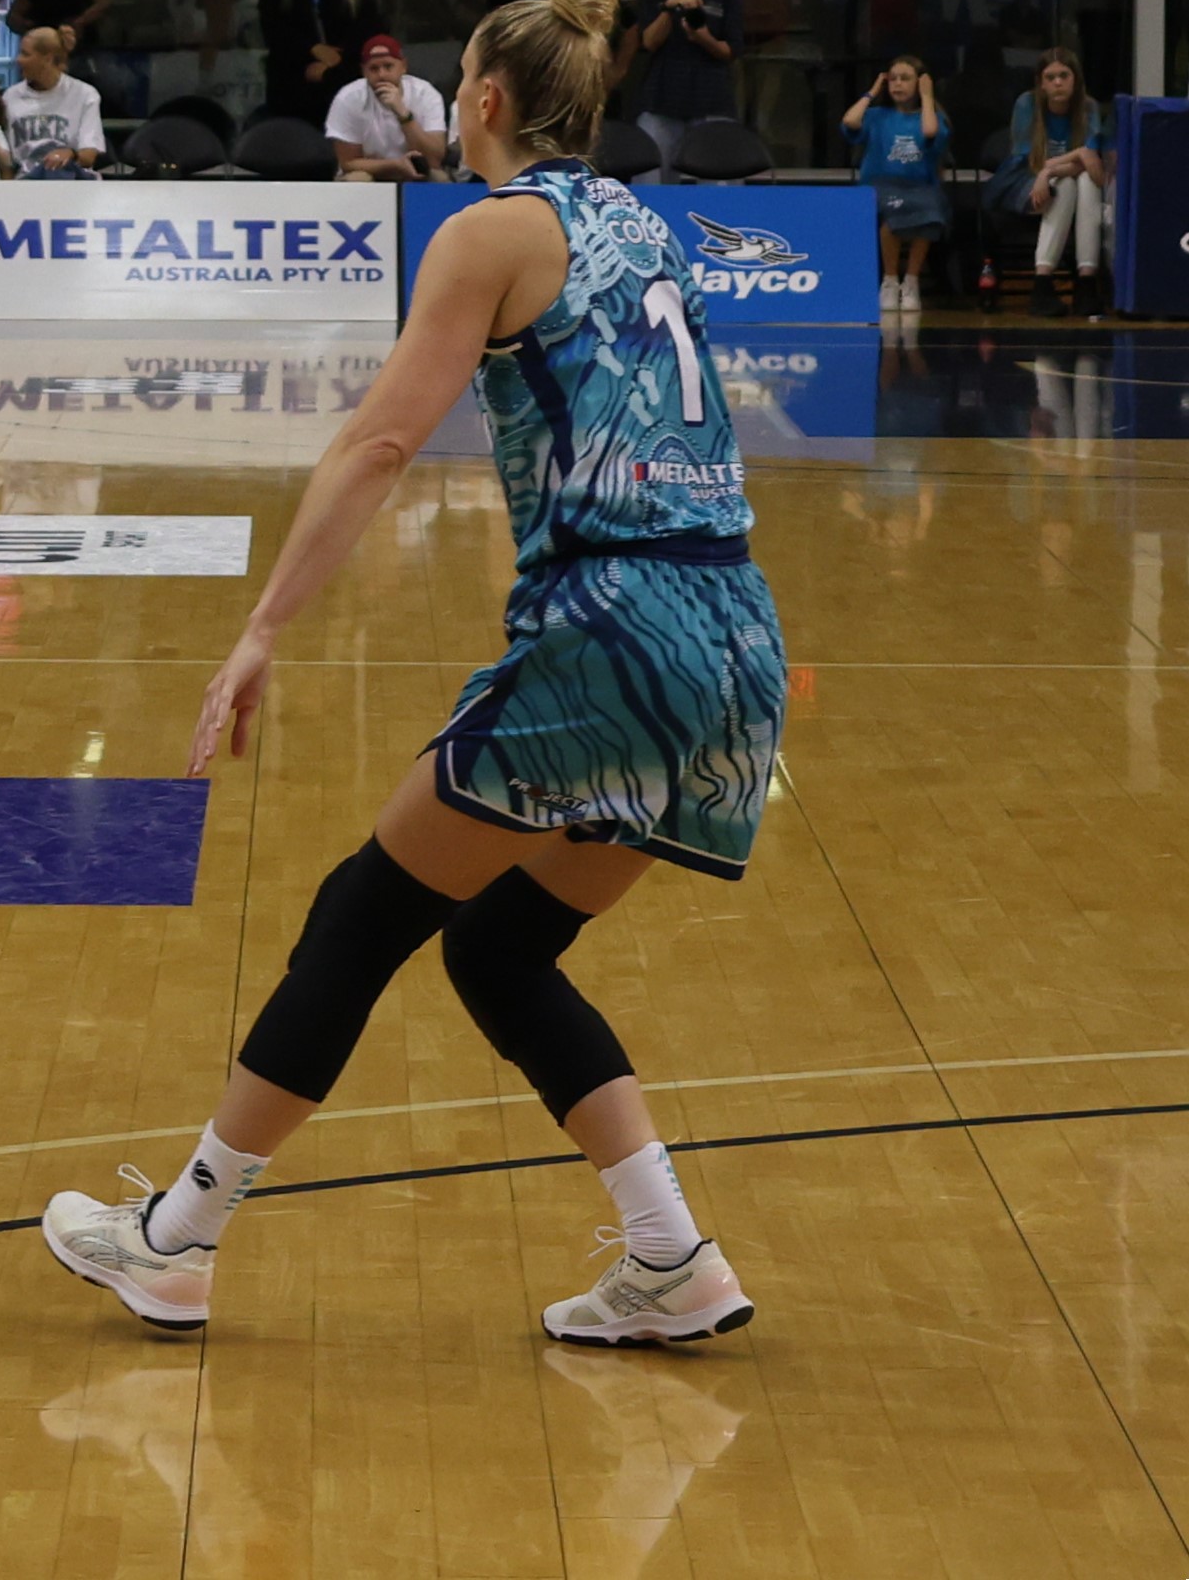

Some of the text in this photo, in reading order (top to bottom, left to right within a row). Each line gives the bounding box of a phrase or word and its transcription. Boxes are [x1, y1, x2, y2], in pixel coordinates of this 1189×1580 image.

[125, 267, 383, 282] AUSTRALIA PTY LTD
[643, 280, 704, 426] 1
